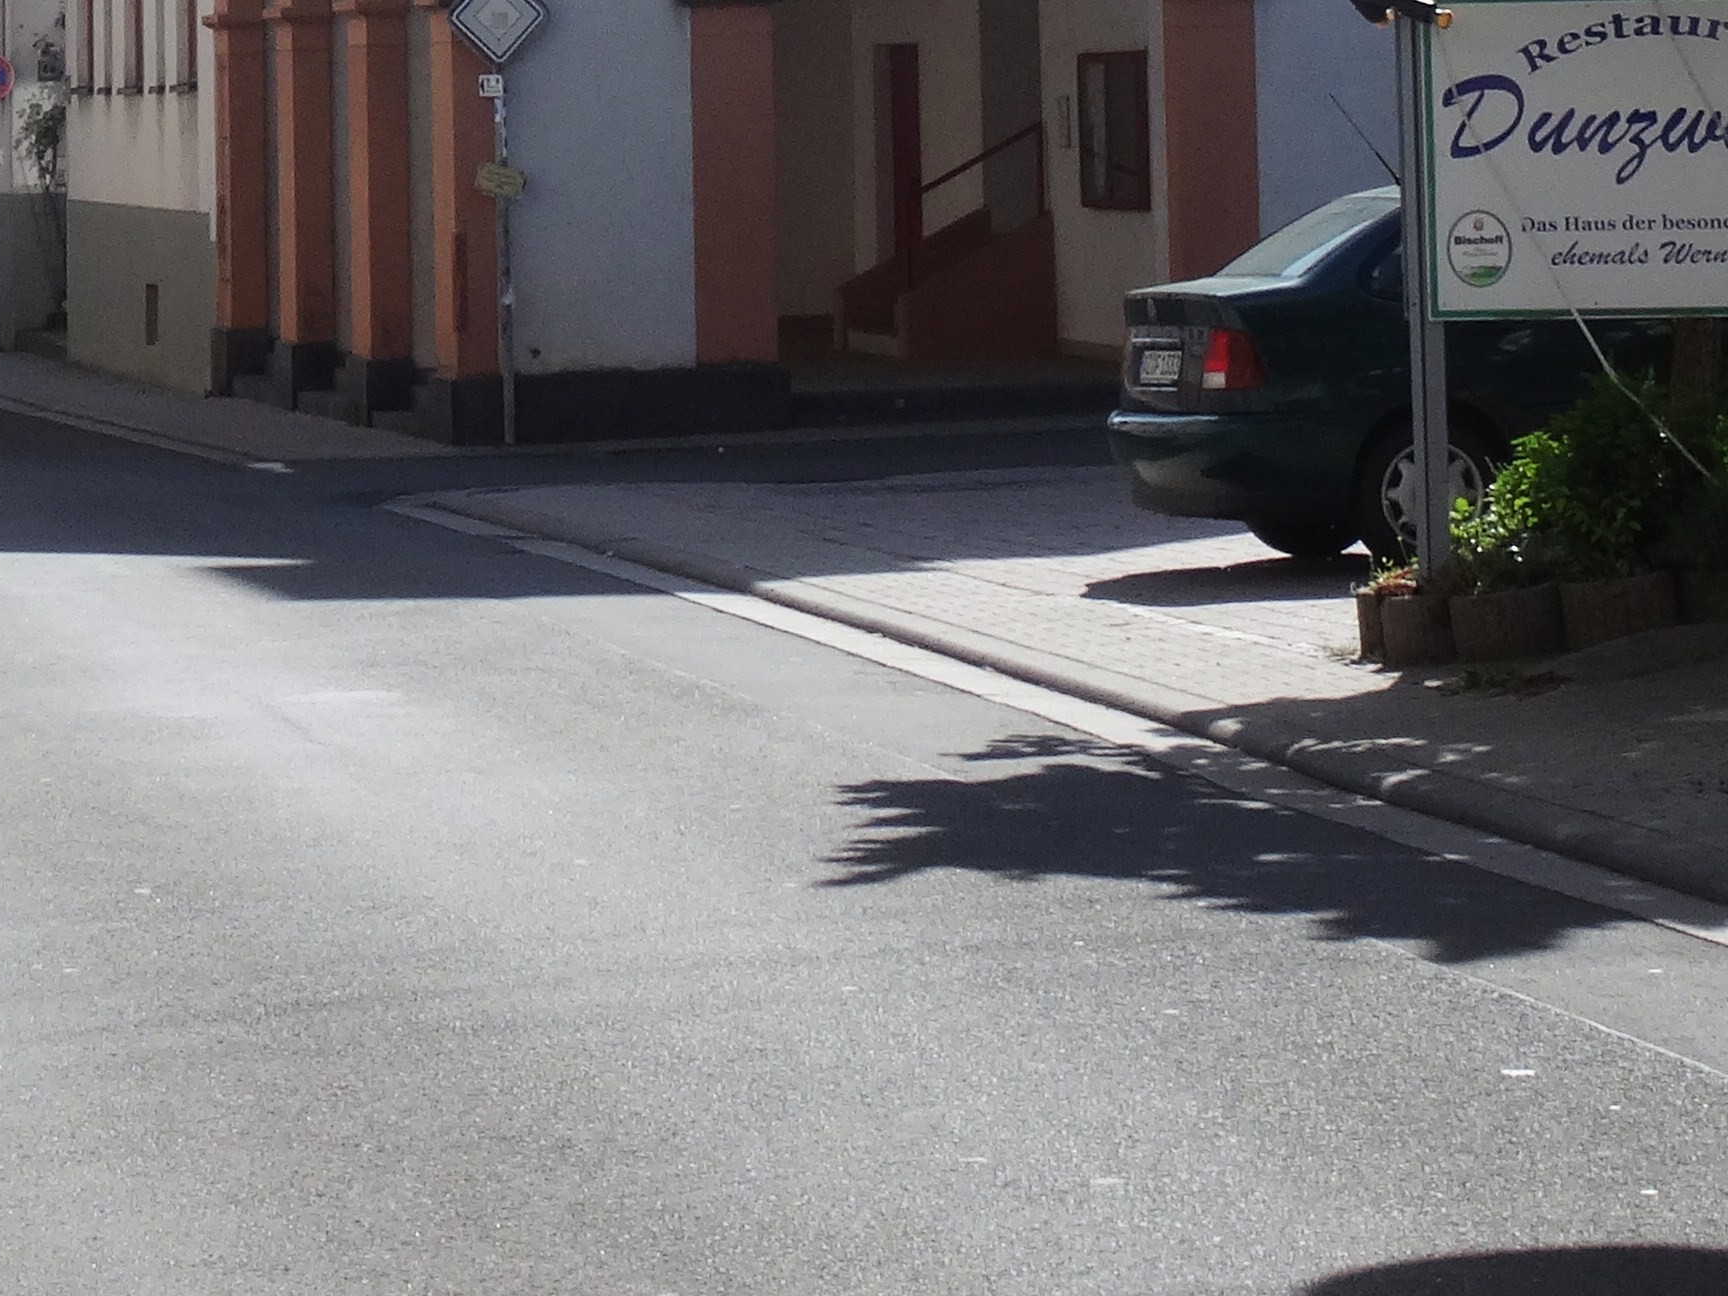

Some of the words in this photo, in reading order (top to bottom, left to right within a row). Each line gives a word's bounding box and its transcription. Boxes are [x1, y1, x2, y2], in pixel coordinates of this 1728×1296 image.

[1521, 216, 1558, 232] Das
[1565, 216, 1616, 232] Haus
[1622, 214, 1657, 230] der
[1454, 235, 1504, 245] Bischoff
[1551, 240, 1649, 266] ehemals
